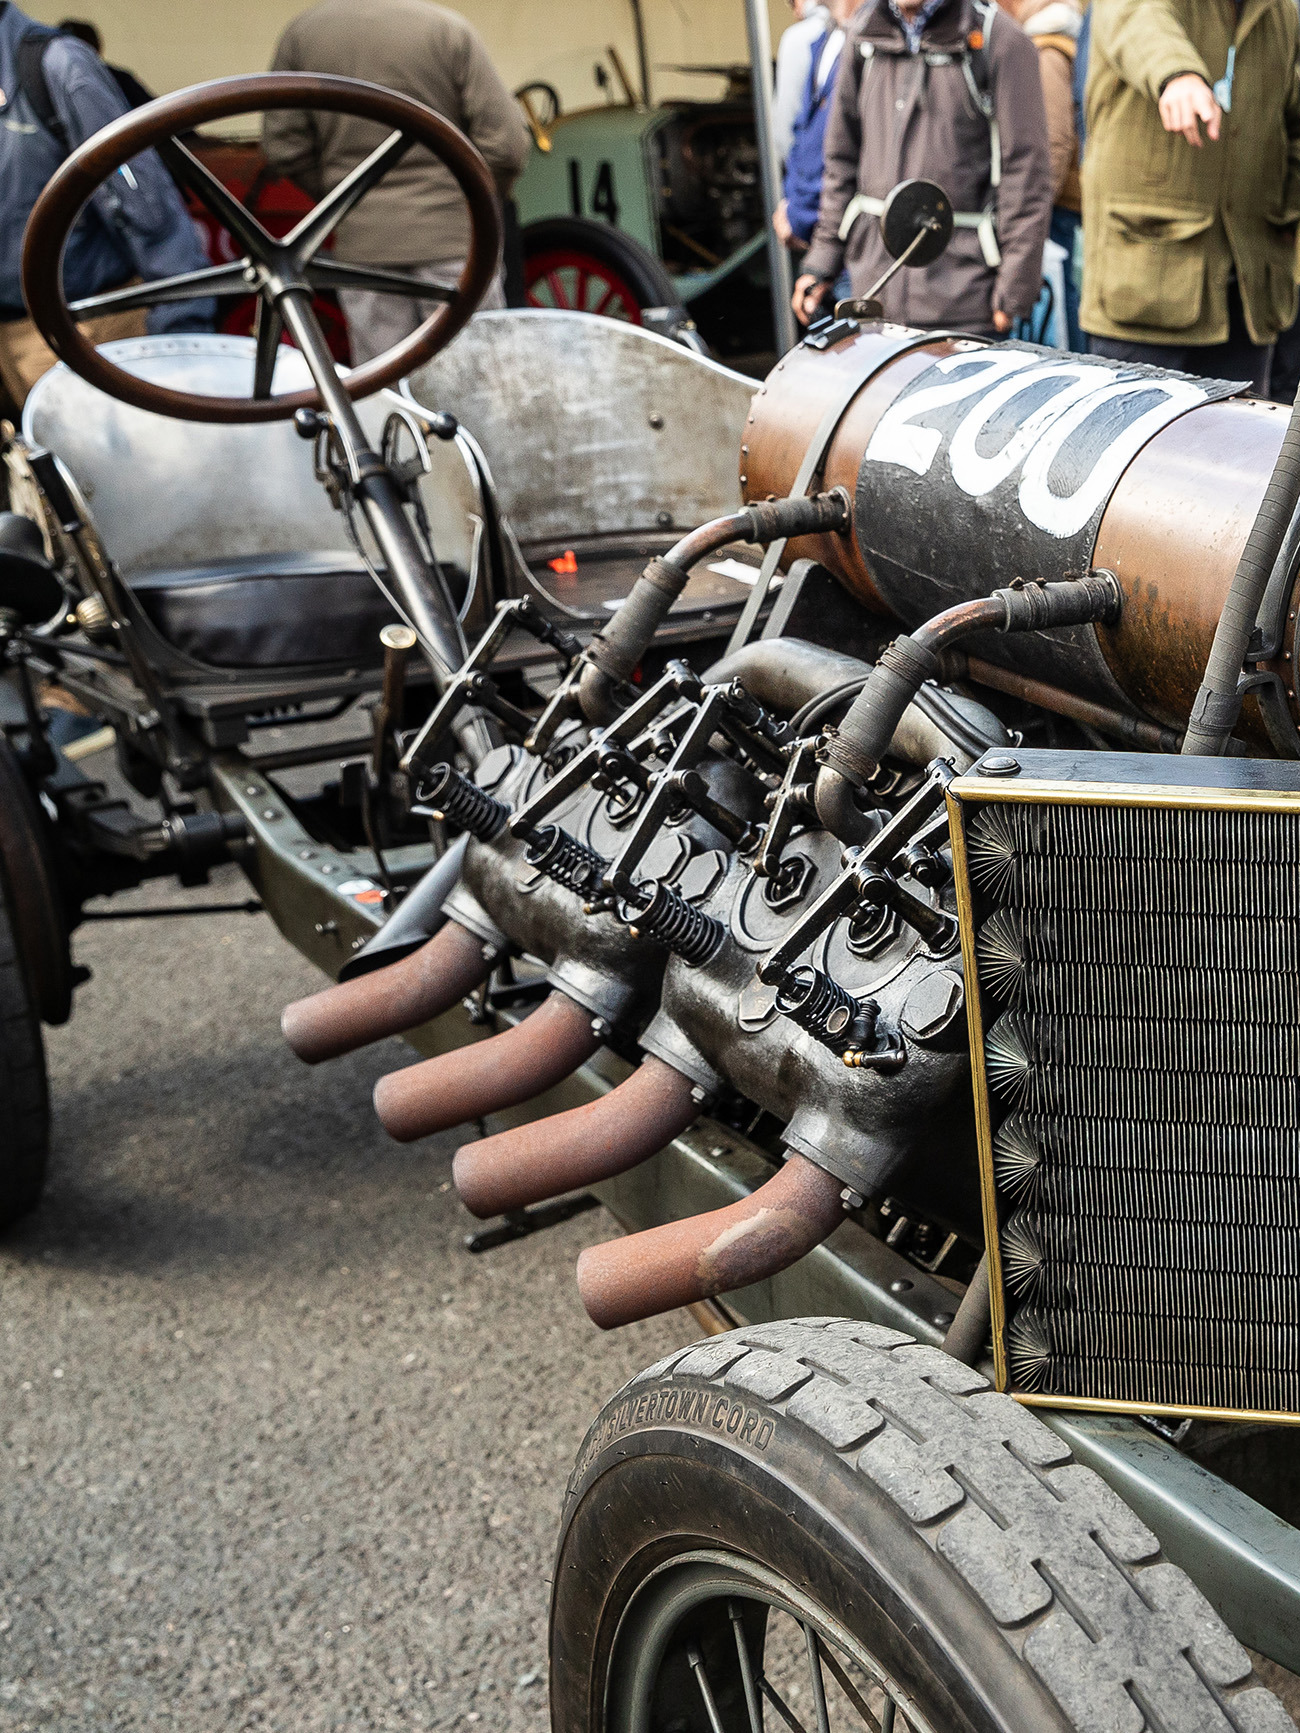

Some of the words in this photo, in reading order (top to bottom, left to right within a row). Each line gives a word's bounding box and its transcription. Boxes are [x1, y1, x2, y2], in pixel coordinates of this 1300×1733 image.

[568, 157, 619, 225] 14
[865, 348, 1210, 540] 200
[606, 1387, 711, 1441] SILVERTOWN
[712, 1397, 776, 1451] CORD
